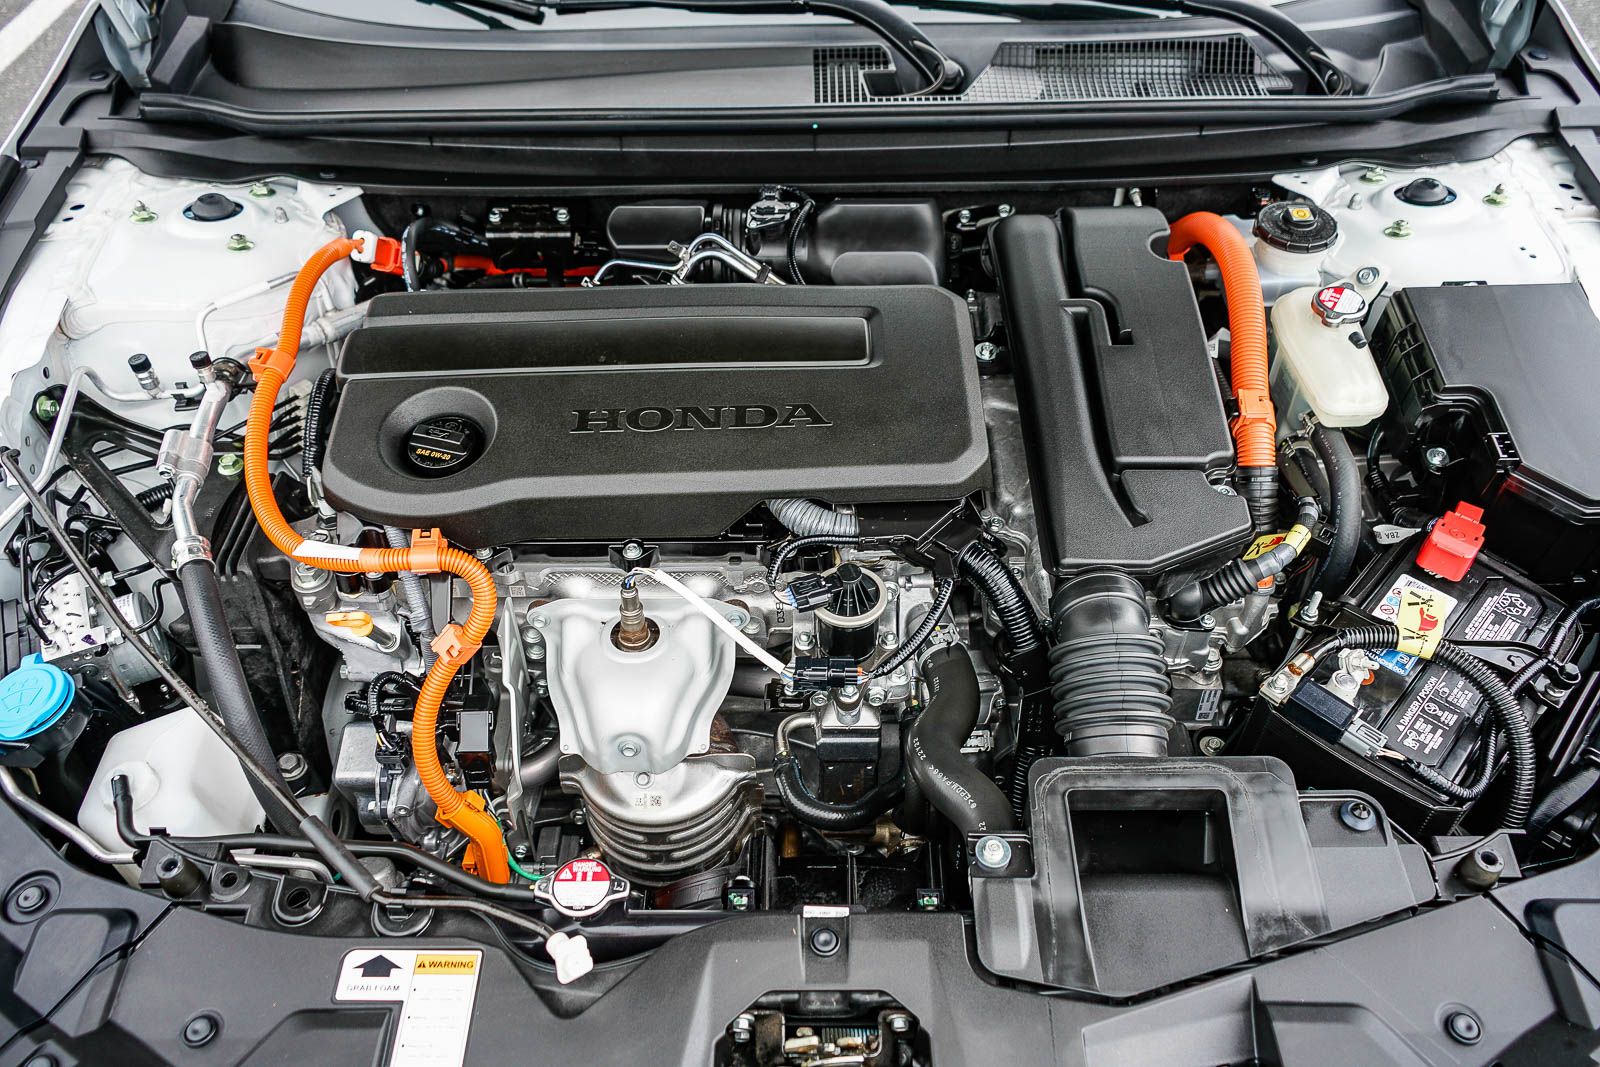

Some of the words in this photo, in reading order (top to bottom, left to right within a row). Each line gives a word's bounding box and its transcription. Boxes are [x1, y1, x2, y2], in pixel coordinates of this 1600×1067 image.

[569, 403, 833, 434] HONDA
[430, 449, 452, 460] 0W-20
[428, 960, 474, 969] WARNING
